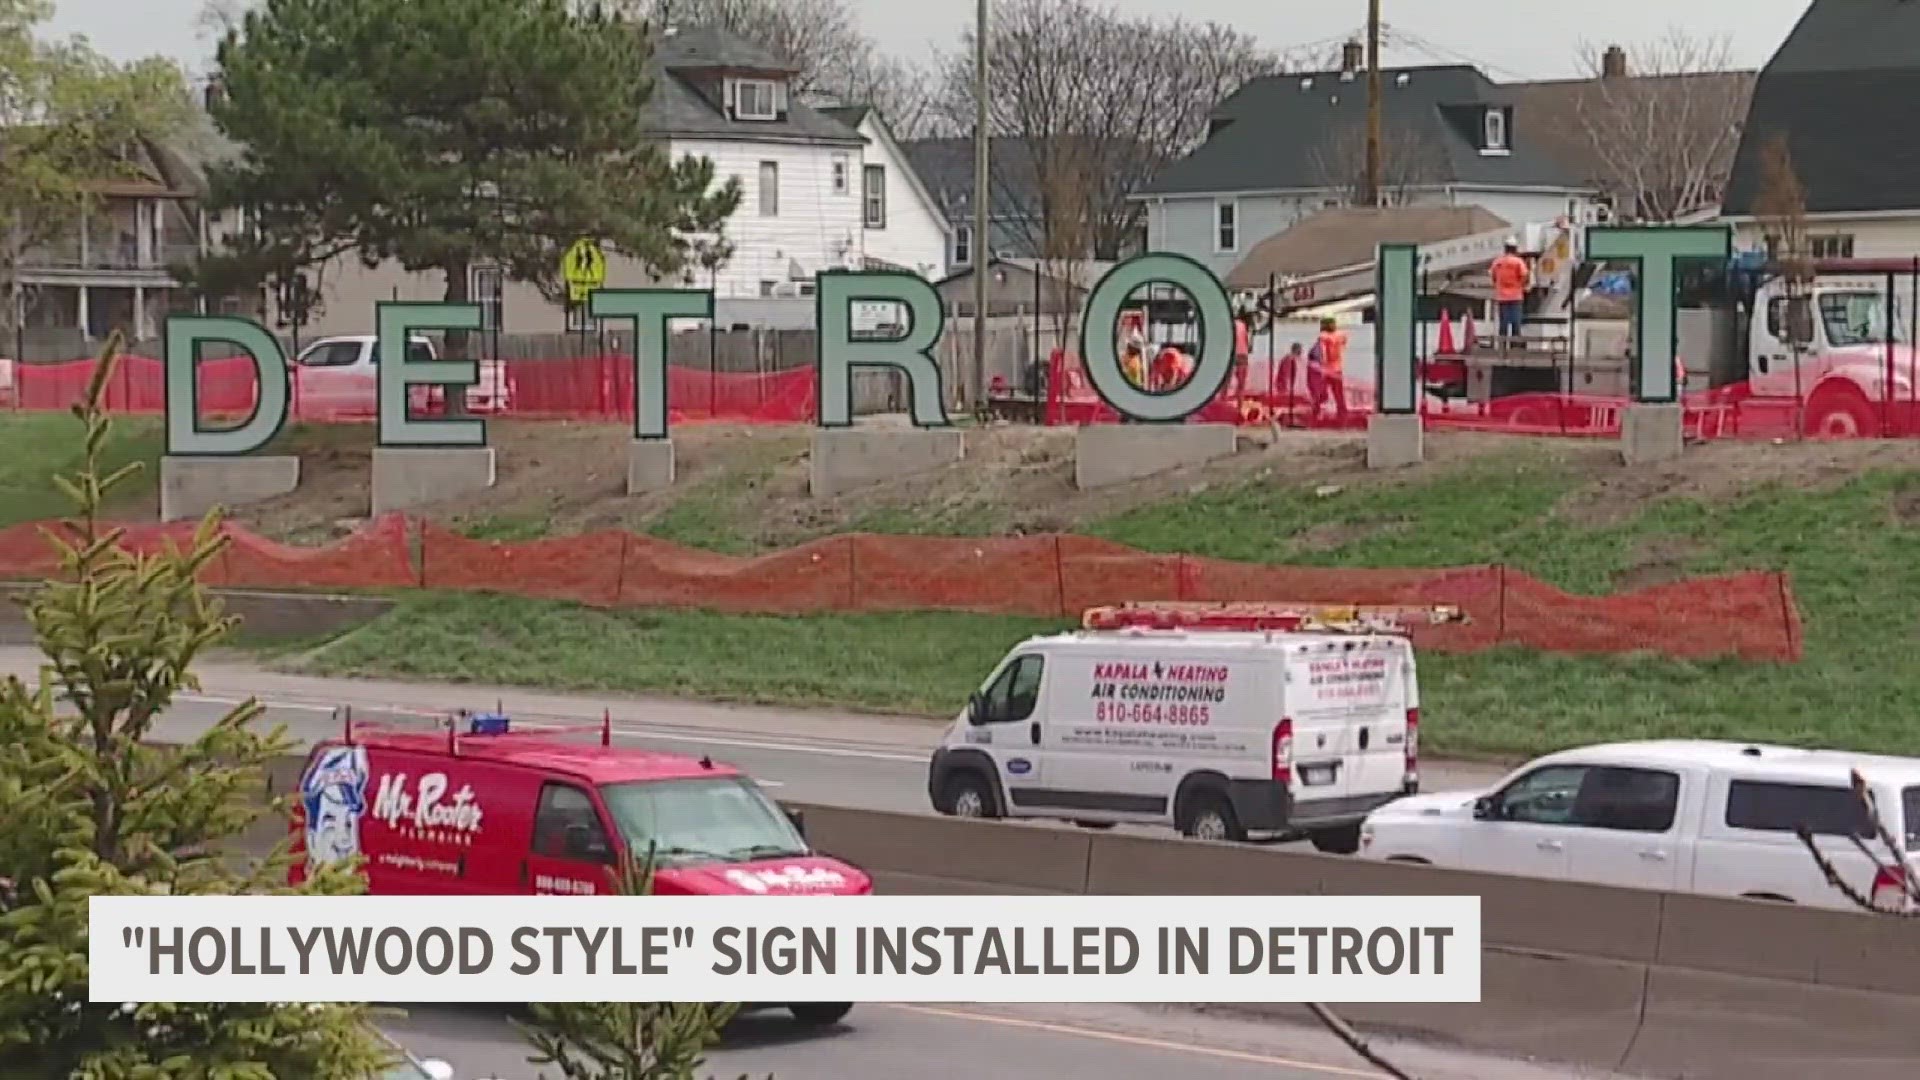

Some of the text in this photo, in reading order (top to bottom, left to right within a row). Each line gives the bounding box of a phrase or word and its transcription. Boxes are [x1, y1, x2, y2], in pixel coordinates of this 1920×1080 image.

[164, 223, 1732, 456] DETROIT
[1093, 662, 1229, 683] KAPALA HEATING
[1091, 683, 1226, 704] AIR CONDITIONING
[1096, 702, 1211, 726] 810-664-8865
